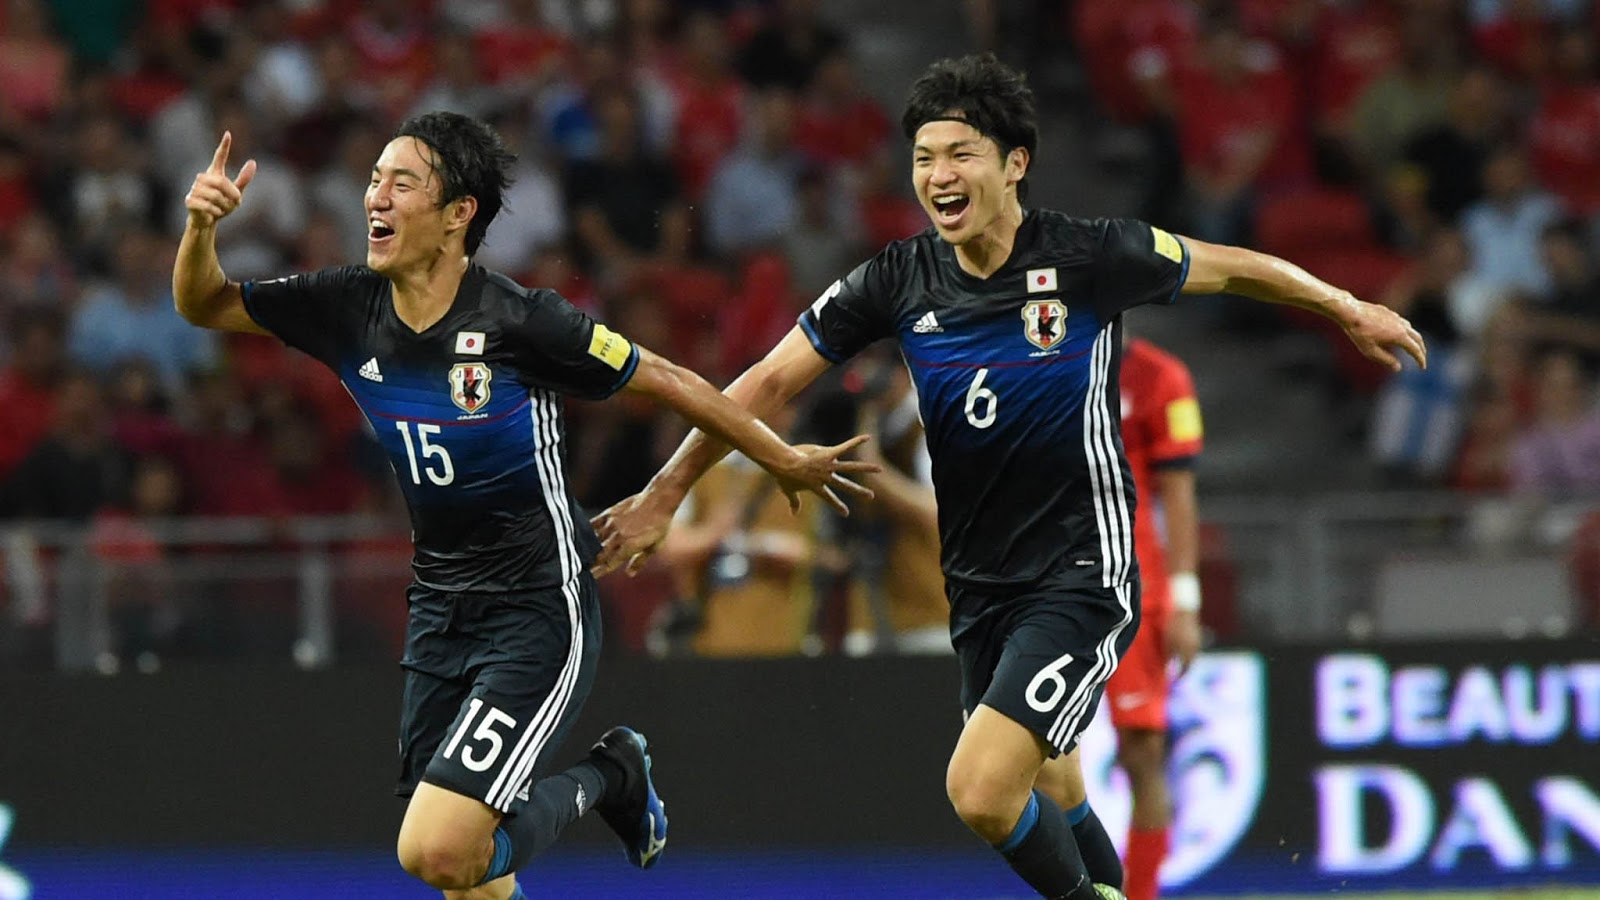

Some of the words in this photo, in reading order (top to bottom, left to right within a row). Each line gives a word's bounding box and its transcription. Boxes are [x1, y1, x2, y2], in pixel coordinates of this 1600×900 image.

[358, 368, 383, 383] adidas
[964, 368, 998, 429] 6
[396, 421, 455, 486] 15
[1025, 653, 1074, 713] 6
[443, 698, 517, 772] 15
